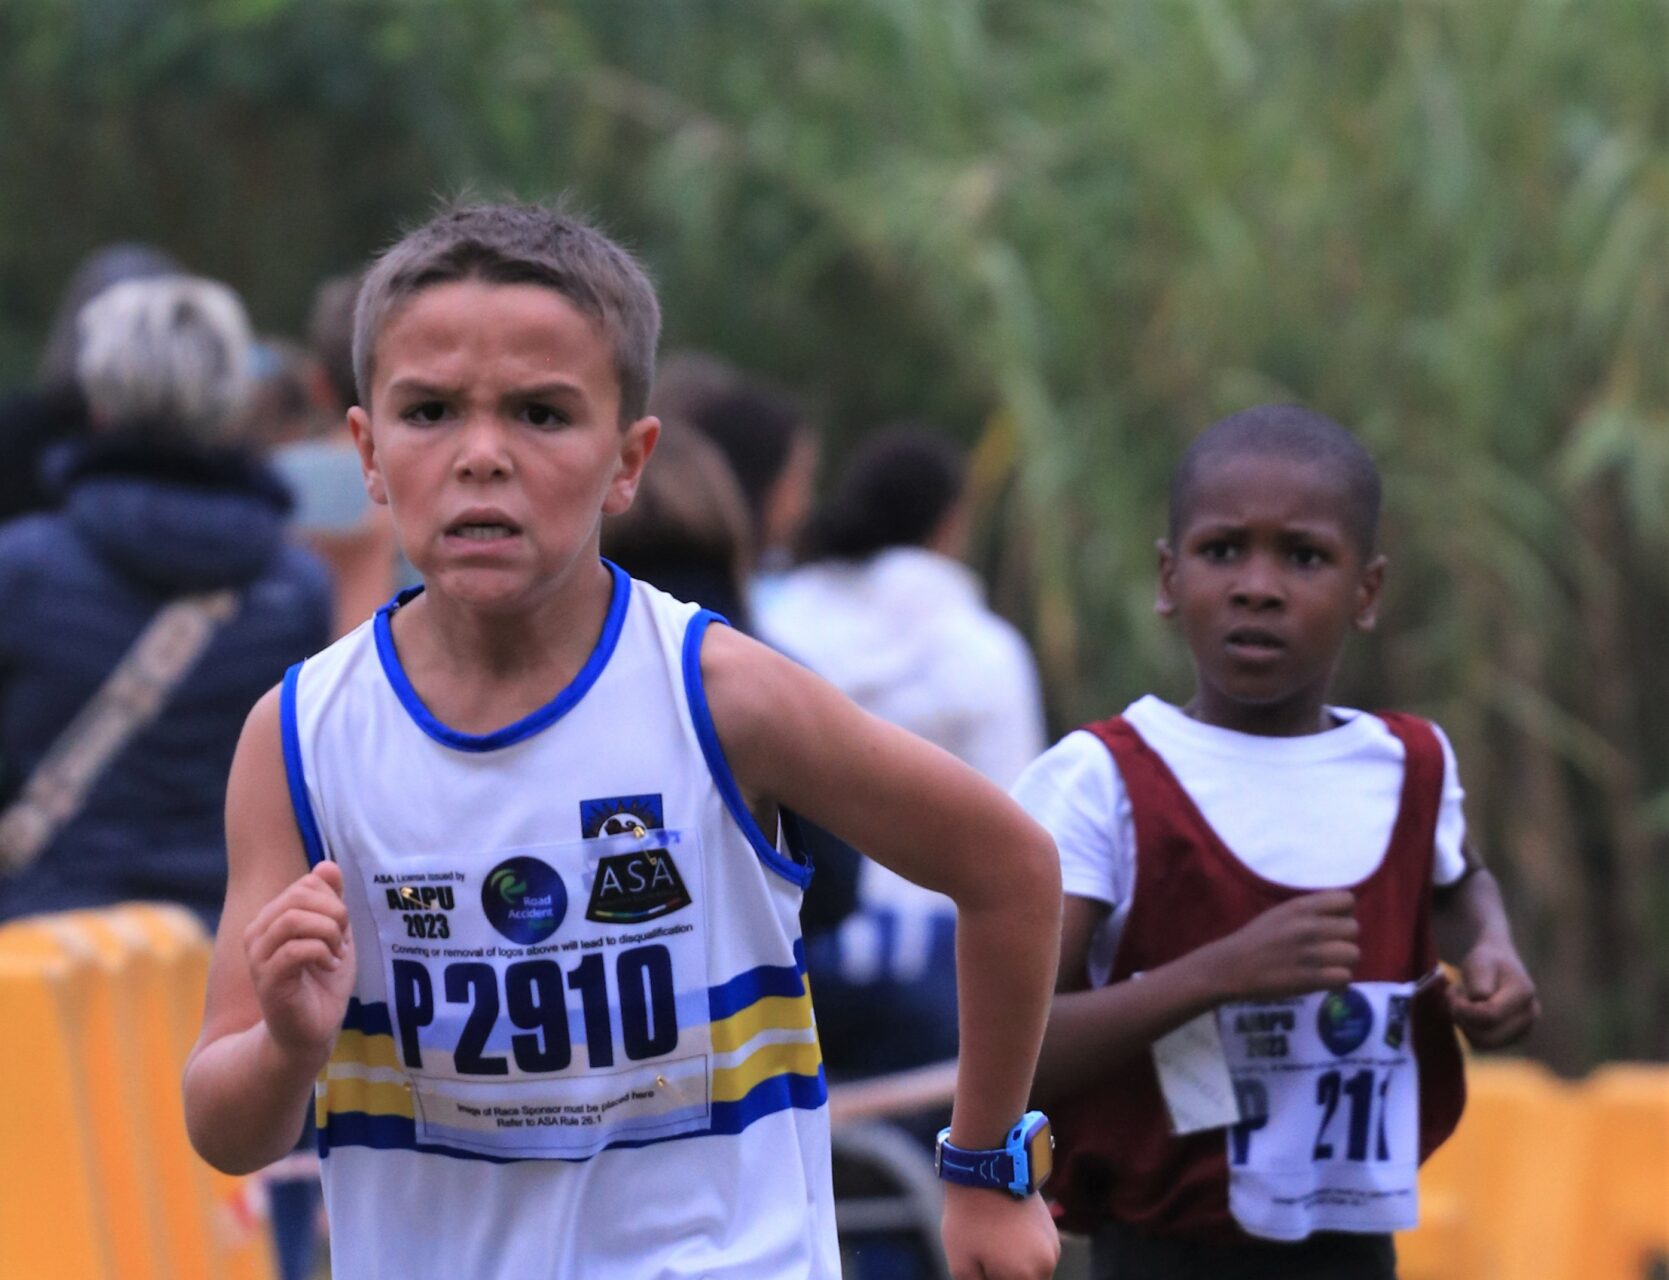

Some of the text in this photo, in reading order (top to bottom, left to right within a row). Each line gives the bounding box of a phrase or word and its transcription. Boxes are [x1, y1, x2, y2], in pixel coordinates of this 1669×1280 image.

[373, 873, 395, 883] ASA
[455, 871, 465, 883] by
[600, 857, 674, 897] ASA
[523, 894, 552, 906] Road
[507, 907, 553, 919] Accident
[402, 913, 450, 939] 2023
[391, 923, 693, 959] Covering or removal of logos above will lead to disqualification
[483, 1107, 492, 1116] of
[493, 1107, 519, 1116] Race
[521, 1105, 561, 1116] Sponsor
[564, 1104, 584, 1114] must
[586, 1103, 599, 1113] be
[601, 1093, 630, 1113] placed
[631, 1089, 655, 1100] here
[496, 1117, 522, 1127] Refer
[525, 1118, 535, 1127] to
[537, 1116, 559, 1126] ASA
[560, 1116, 579, 1126] Rule
